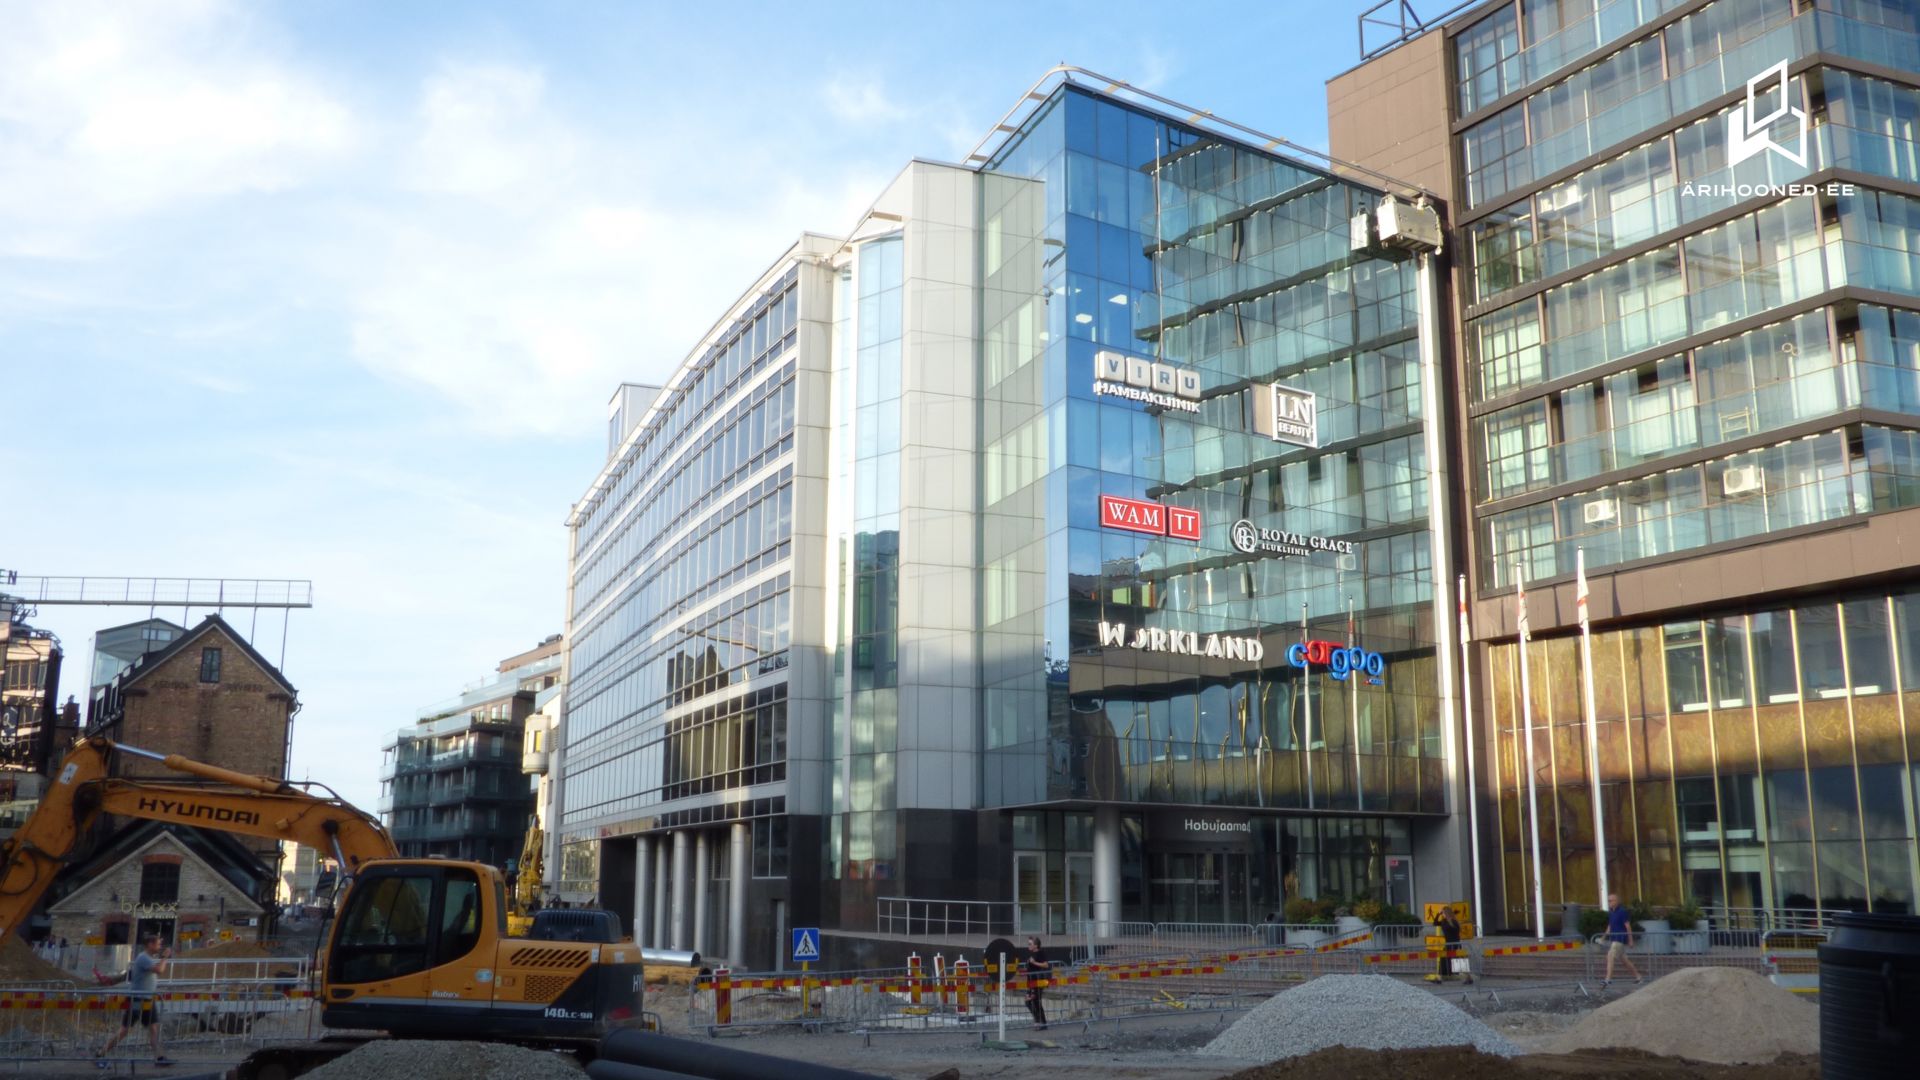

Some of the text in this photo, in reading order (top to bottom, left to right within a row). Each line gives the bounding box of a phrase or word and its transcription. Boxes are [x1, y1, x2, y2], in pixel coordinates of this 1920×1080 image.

[1108, 358, 1196, 390] VIRU
[1096, 381, 1200, 413] HAMBAKLIINIK
[1278, 393, 1311, 424] LN
[1278, 422, 1311, 438] BEAUTY
[1108, 502, 1195, 532] WAM TT
[1262, 528, 1352, 554] ROYAL GRACE
[1262, 542, 1310, 556] ILUKLIINIK
[1286, 641, 1384, 680] cargoo
[138, 798, 260, 825] HYUNDAI
